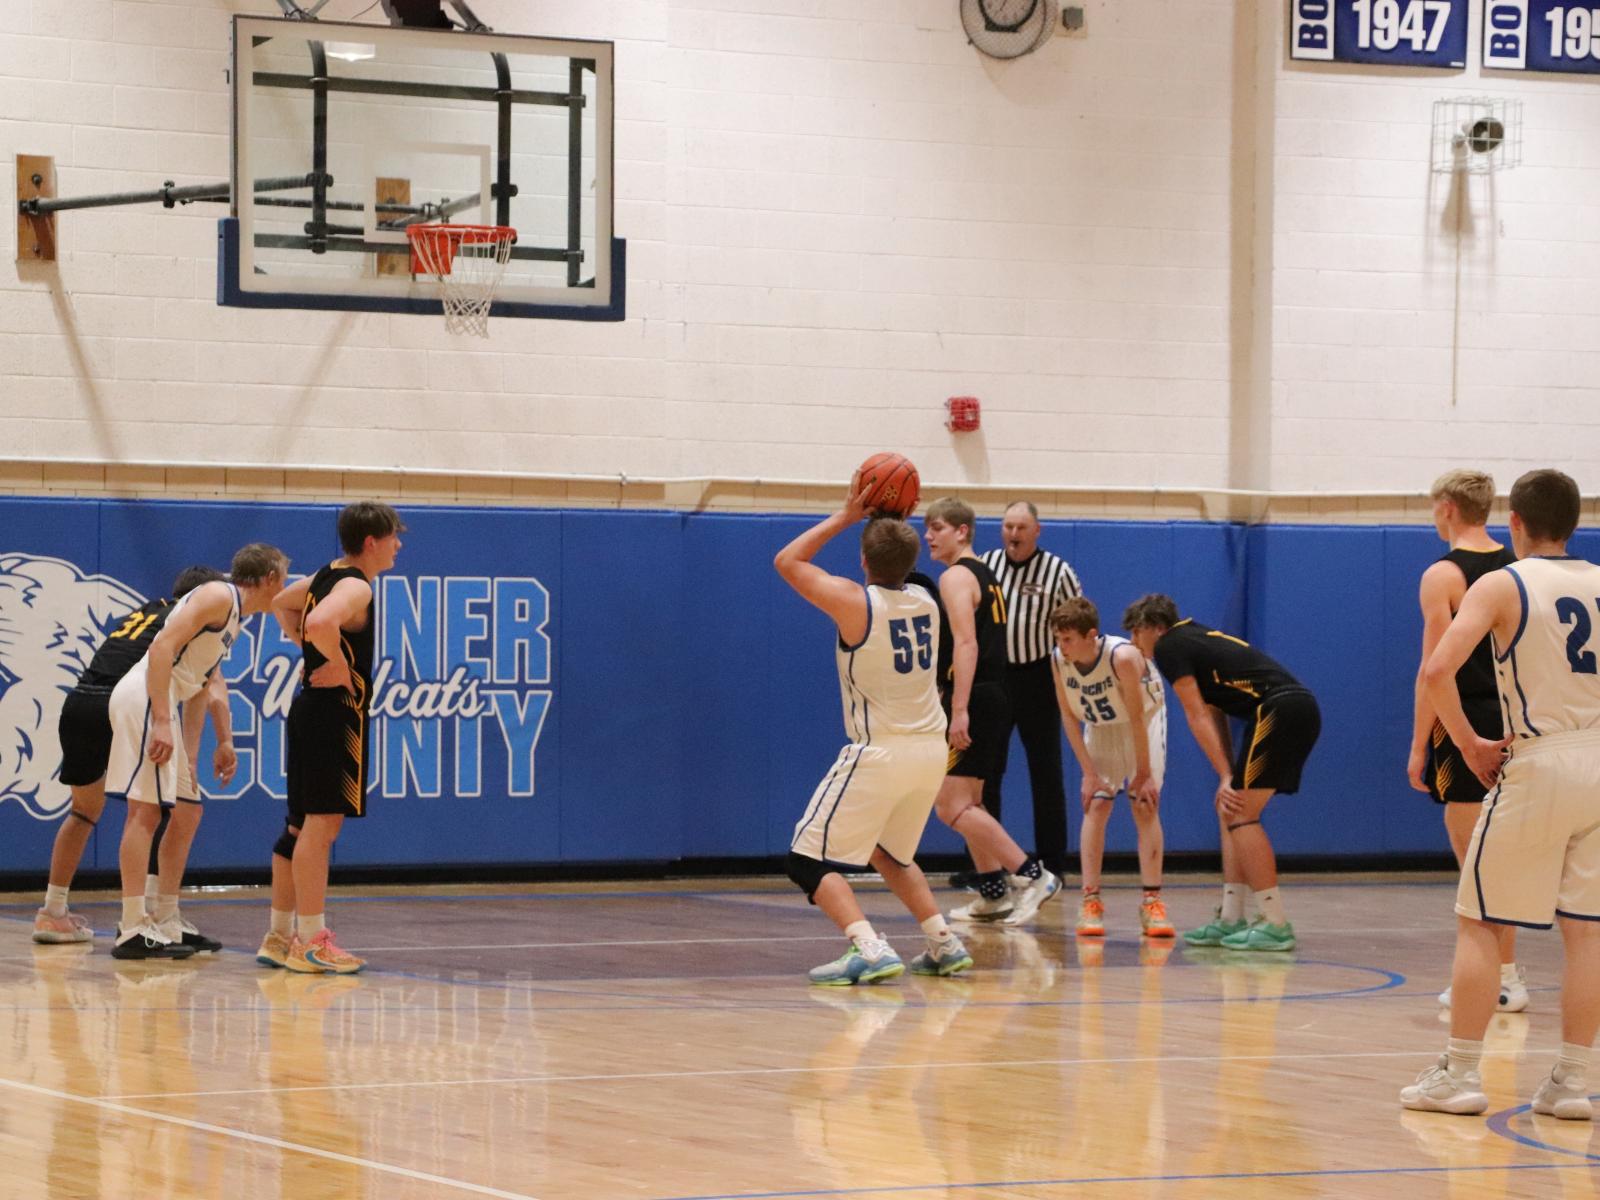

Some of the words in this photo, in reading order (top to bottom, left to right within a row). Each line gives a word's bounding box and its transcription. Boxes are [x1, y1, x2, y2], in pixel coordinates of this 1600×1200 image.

[1352, 0, 1451, 52] 1947
[110, 611, 158, 640] 31
[221, 573, 550, 684] NER
[888, 614, 932, 674] 55
[1555, 596, 1600, 674] 2
[263, 656, 485, 721] Wcats
[1066, 676, 1113, 696] WDCATS
[1080, 695, 1117, 723] 35
[198, 689, 552, 799] CNTY
